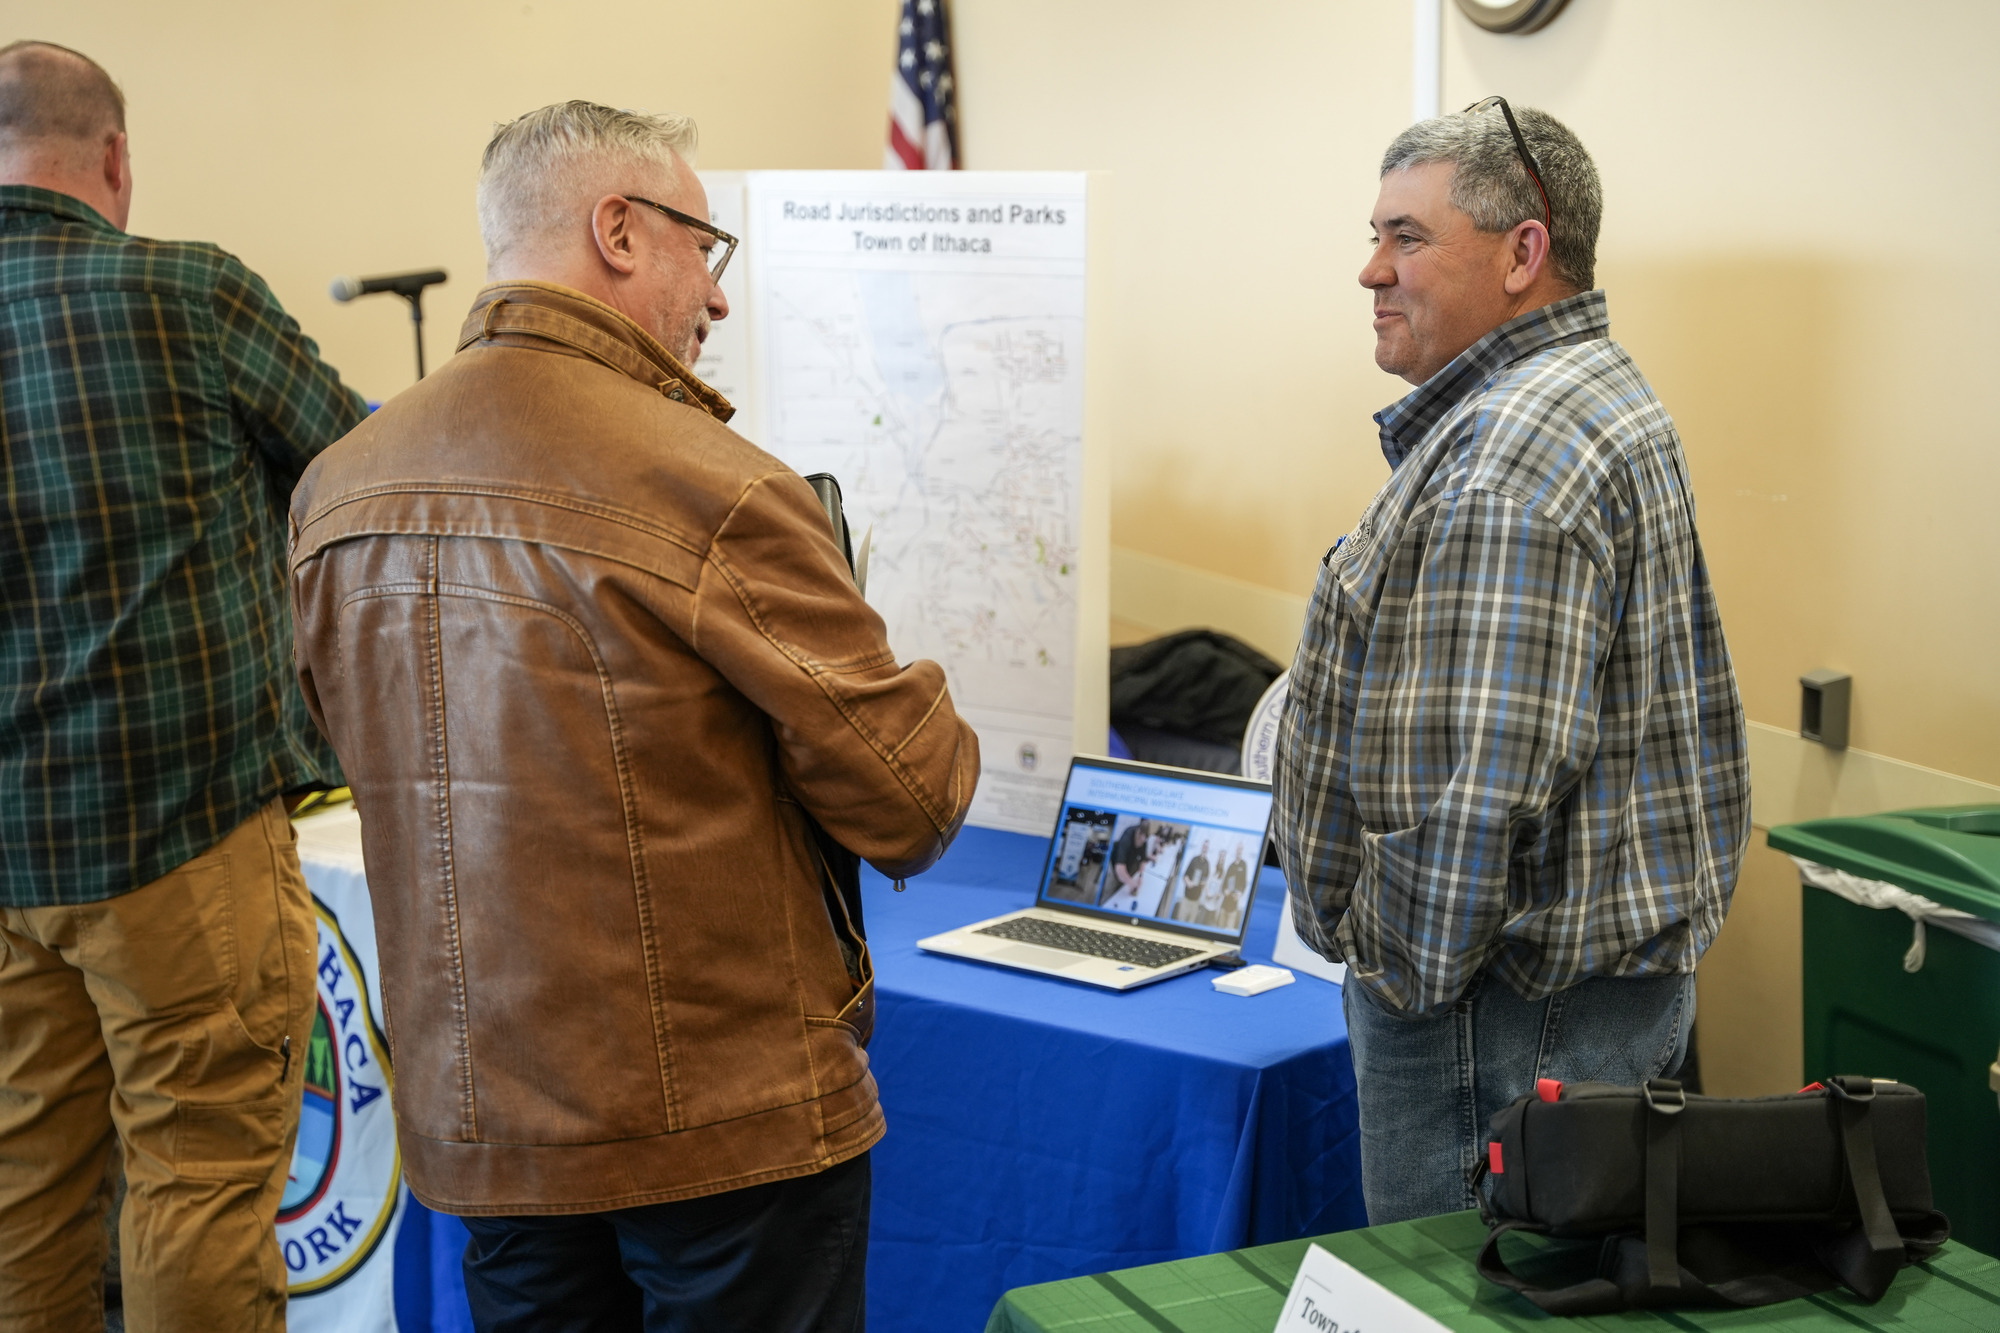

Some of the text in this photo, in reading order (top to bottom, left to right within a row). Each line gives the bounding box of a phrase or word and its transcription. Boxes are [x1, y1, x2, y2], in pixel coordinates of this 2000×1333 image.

[782, 201, 1067, 226] Road Jurisdictions and Parks
[853, 231, 993, 254] Town of Ithaca
[317, 936, 382, 1114] HACA
[281, 1200, 362, 1274] ORK
[1301, 1297, 1340, 1333] Town
